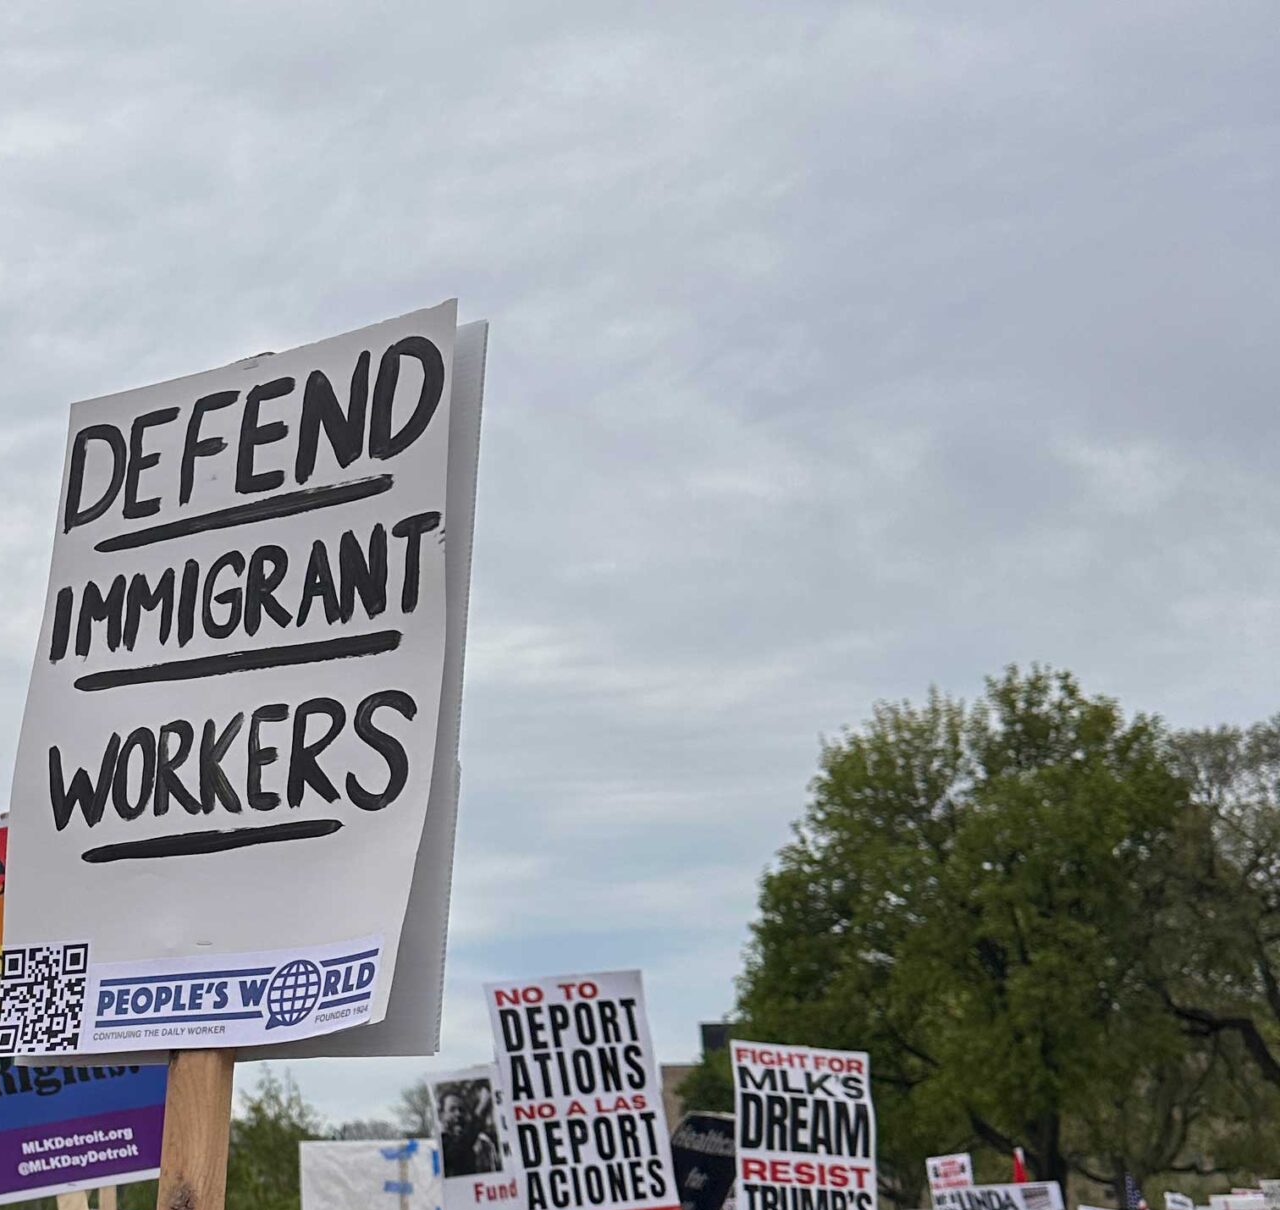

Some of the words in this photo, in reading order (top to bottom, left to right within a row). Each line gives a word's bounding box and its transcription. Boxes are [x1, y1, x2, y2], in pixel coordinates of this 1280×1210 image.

[63, 335, 444, 534] DEFEND
[49, 511, 442, 664] IMMIGRANT
[48, 689, 418, 832] WORKERS
[96, 982, 228, 1017] PEOPLE'S
[494, 986, 545, 1006] NO
[557, 981, 598, 1000] TO
[93, 1030, 141, 1041] CONTINUING
[144, 1029, 160, 1037] THE
[161, 1027, 186, 1037] DAILY
[187, 1025, 226, 1035] WORKER
[499, 998, 641, 1053] DEPORT
[509, 1045, 646, 1101] ATIONS
[735, 1047, 808, 1069] FIGHT
[814, 1054, 863, 1074] FOR
[737, 1066, 865, 1100] MLK'S
[513, 1104, 558, 1121] NO
[565, 1100, 587, 1117] A
[595, 1094, 647, 1113] LAS
[22, 1128, 133, 1155] MLKDetroit.org
[517, 1112, 659, 1169] DEPORT
[740, 1092, 870, 1158] DREAM
[474, 1177, 517, 1203] Fund
[741, 1157, 870, 1189] RESIST
